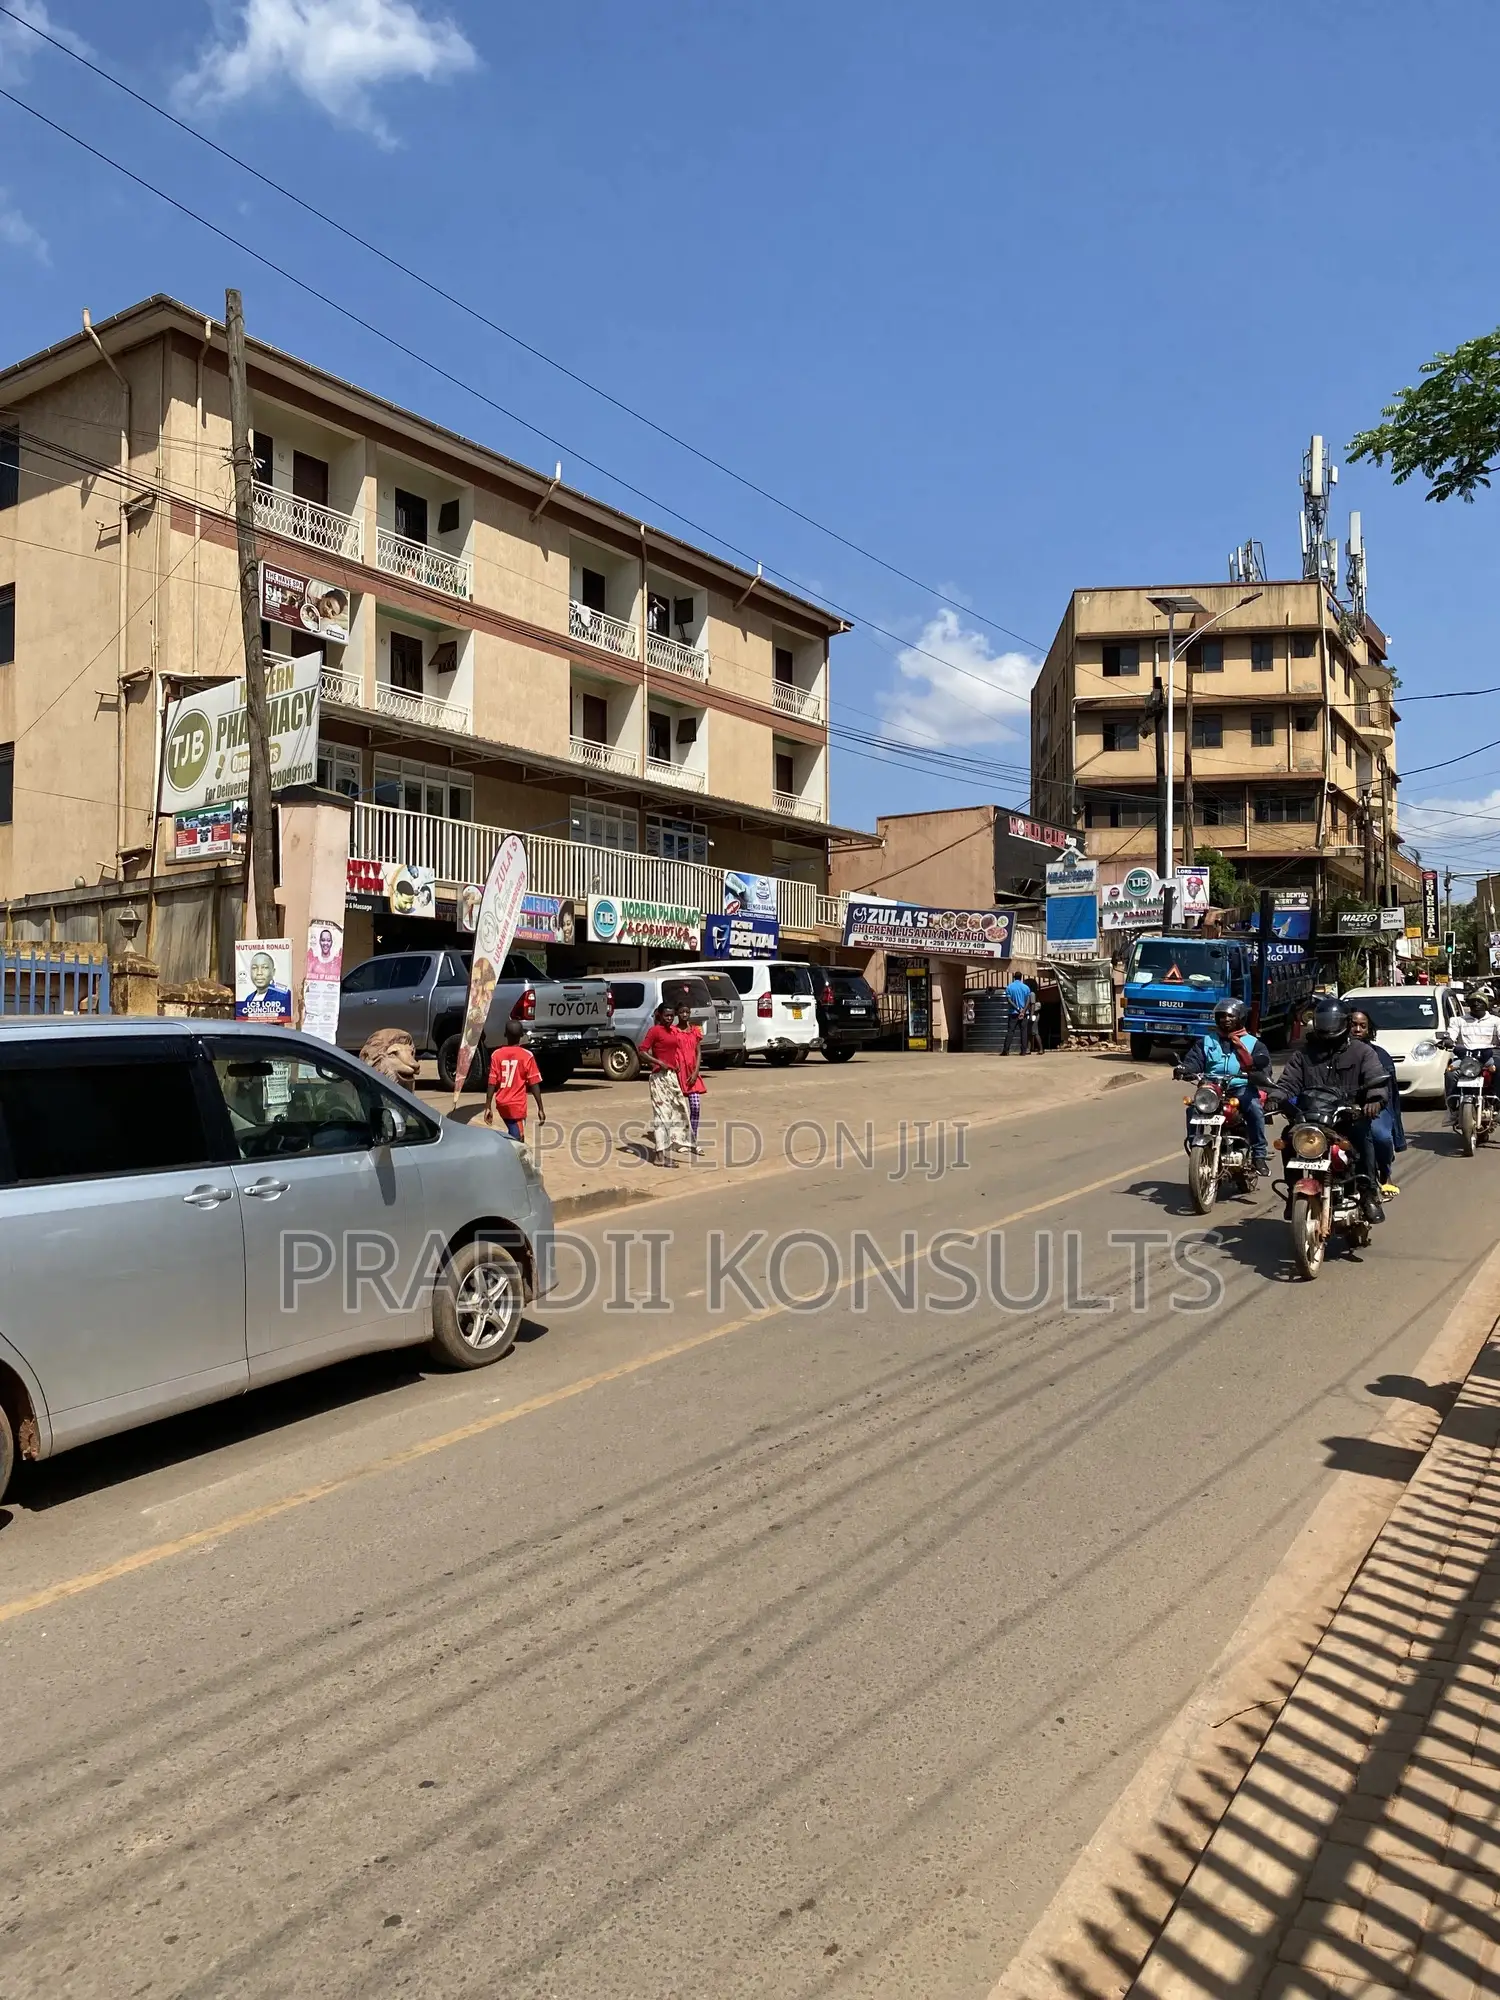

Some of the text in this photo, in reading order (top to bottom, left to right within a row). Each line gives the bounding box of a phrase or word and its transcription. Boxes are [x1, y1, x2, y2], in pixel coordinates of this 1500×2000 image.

[266, 570, 303, 589] THE WAVE SPA
[216, 688, 317, 752] PHAMACY
[172, 729, 205, 769] TJB
[205, 786, 217, 801] For
[217, 778, 249, 799] Deliverie
[1044, 826, 1066, 849] CLUB
[1130, 877, 1149, 888] TJB
[621, 900, 658, 921] MODERN
[658, 905, 700, 928] PHARMACY
[866, 906, 929, 928] ZULA'S
[1341, 914, 1378, 923] MAZZO
[1426, 906, 1436, 938] DENTAL
[635, 922, 690, 942] COSMETICS
[730, 930, 778, 949] DENTAL
[852, 923, 985, 942] CHICKEN LUSANIYA MENGO
[1275, 944, 1305, 954] CLUB
[242, 1006, 286, 1014] COUNCILLOR
[548, 1001, 599, 1017] TOYOTA
[500, 1059, 519, 1089] 37
